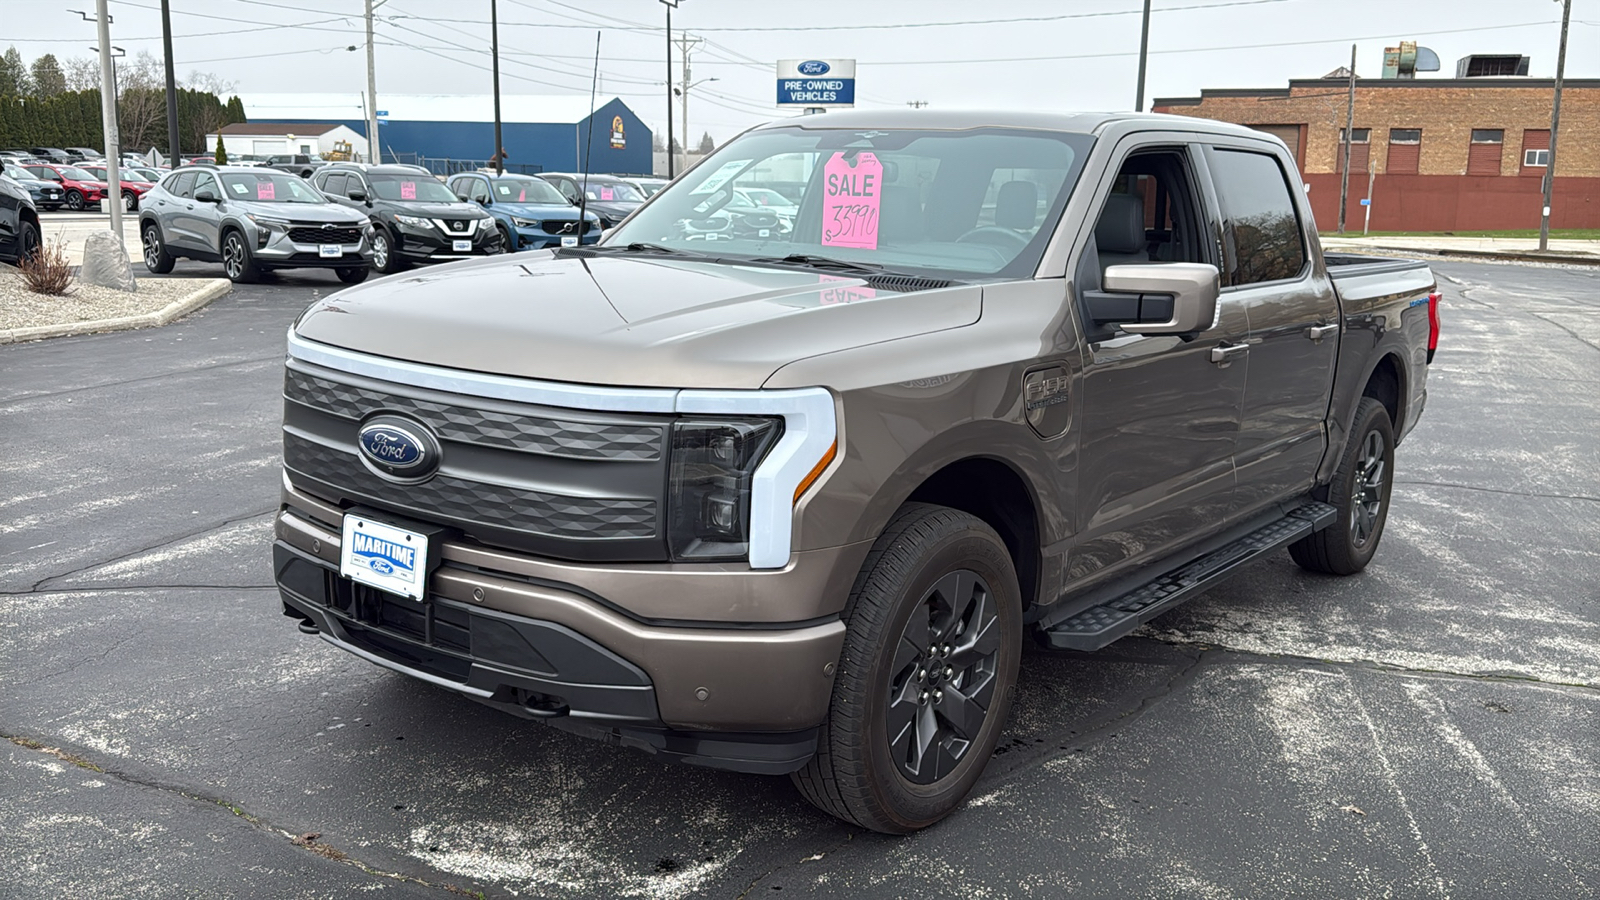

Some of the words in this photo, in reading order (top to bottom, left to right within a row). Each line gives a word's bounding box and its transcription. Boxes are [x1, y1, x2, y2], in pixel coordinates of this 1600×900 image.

[785, 81, 843, 91] PRE-OWNED
[790, 91, 837, 101] VEHICLES
[828, 173, 874, 197] SALE
[371, 432, 406, 460] Ford
[353, 533, 414, 569] MARITIME
[373, 559, 390, 573] Ford
